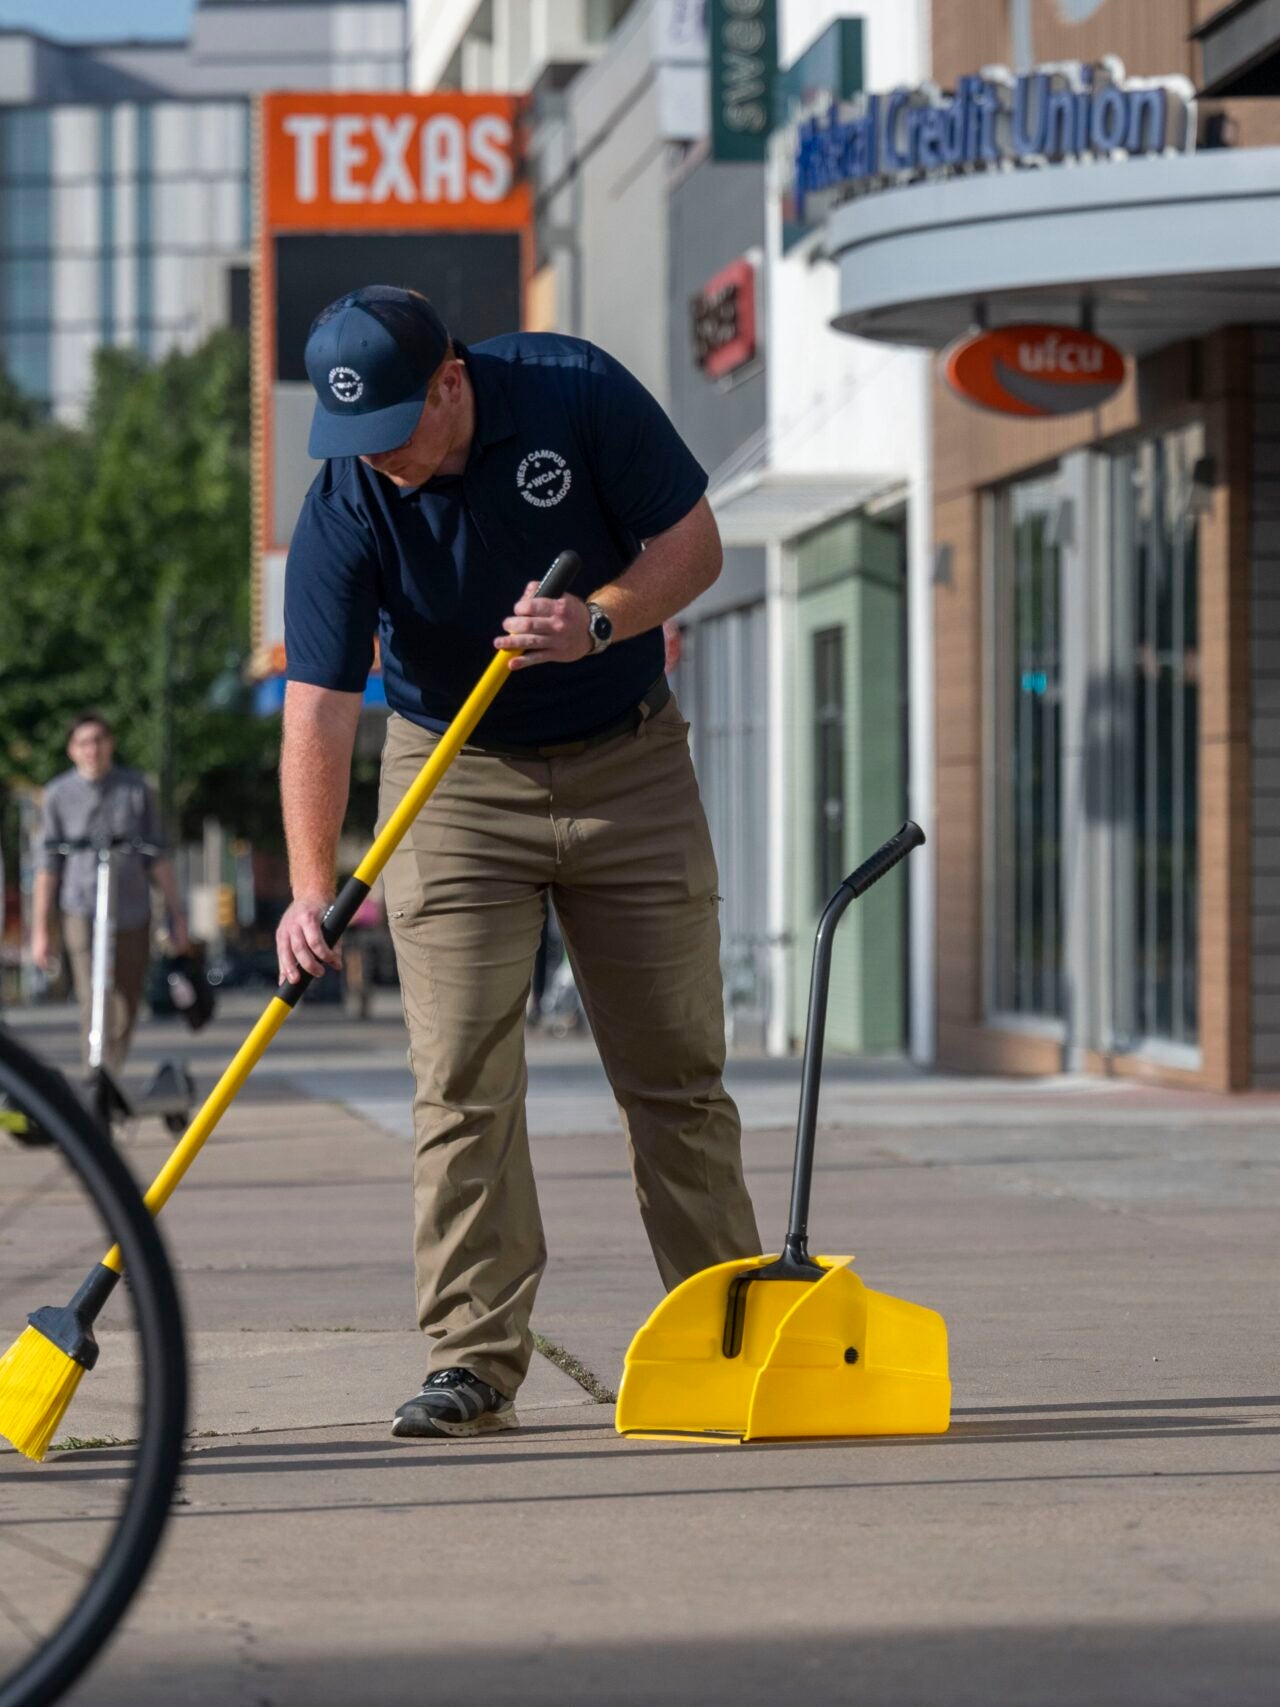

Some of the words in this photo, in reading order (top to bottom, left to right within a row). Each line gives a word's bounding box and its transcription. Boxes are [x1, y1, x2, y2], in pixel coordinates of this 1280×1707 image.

[886, 75, 998, 170] Credit
[1013, 64, 1166, 156] Union
[282, 114, 513, 204] TEXAS
[1019, 333, 1103, 373] ufcu
[516, 458, 529, 487] WEST
[527, 450, 566, 468] CAMPUS
[520, 469, 572, 507] AMBASSADORS
[531, 471, 556, 487] WCA
